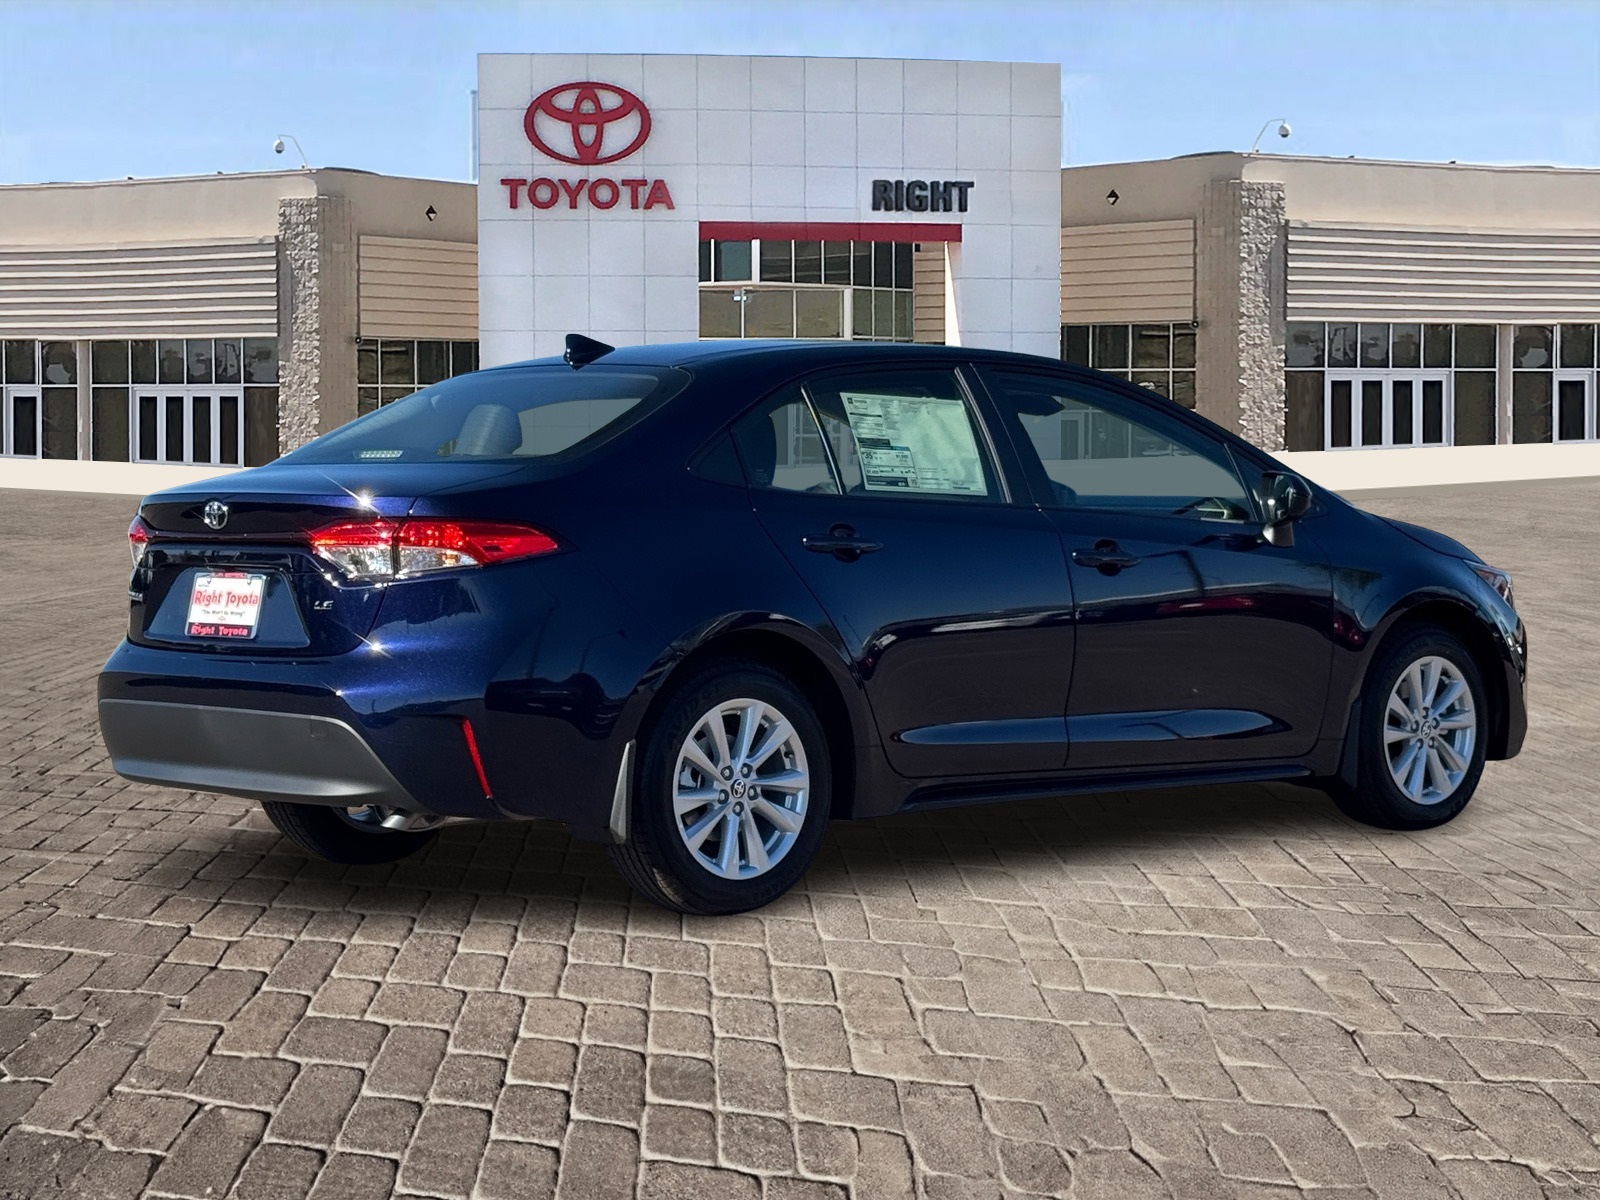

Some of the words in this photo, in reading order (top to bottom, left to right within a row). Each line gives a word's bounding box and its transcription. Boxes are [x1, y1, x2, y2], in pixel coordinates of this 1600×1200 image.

[500, 178, 675, 210] TOYOTA
[872, 180, 975, 212] RIGHT
[194, 589, 222, 607] Right
[225, 591, 259, 608] Toyota
[313, 600, 334, 610] LE
[190, 624, 215, 636] Right
[218, 626, 248, 637] Toyota
